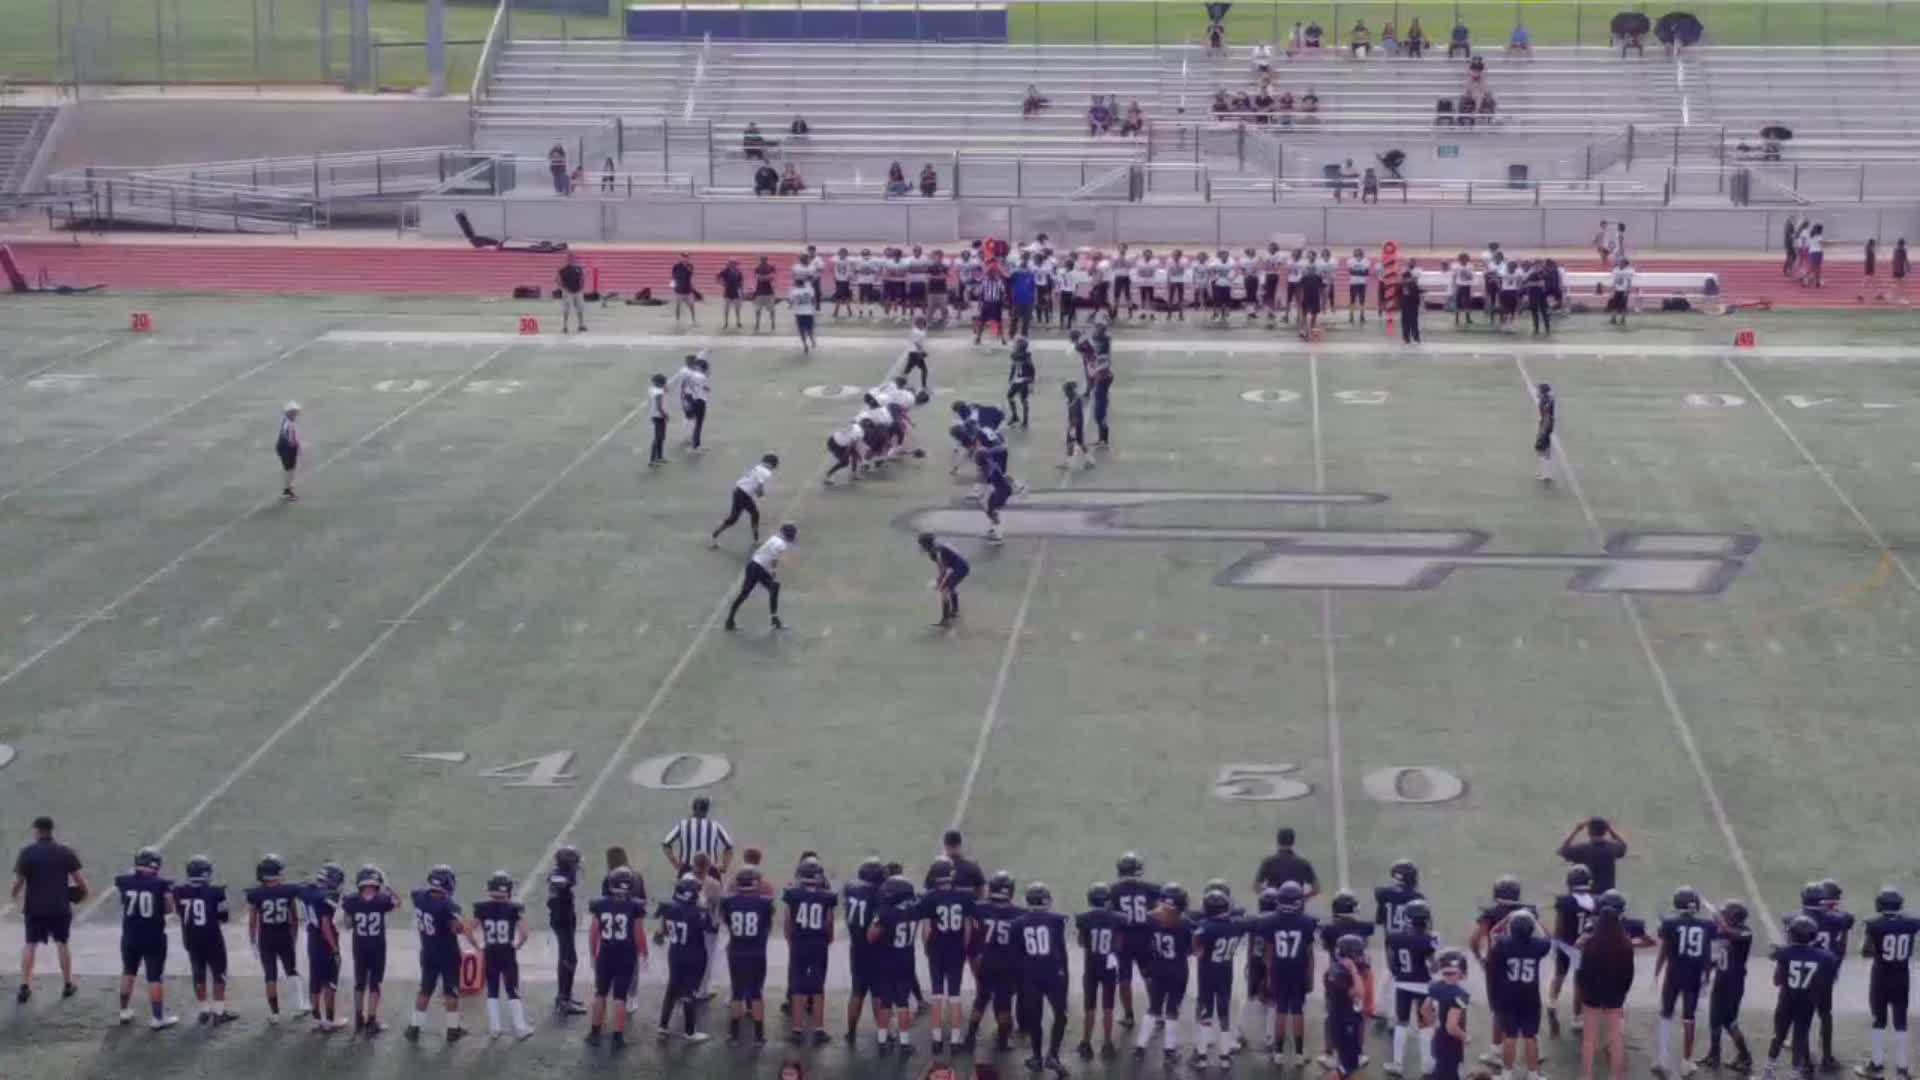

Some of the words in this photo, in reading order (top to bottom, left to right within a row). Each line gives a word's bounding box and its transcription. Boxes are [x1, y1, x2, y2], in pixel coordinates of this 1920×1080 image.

[125, 891, 153, 918] 70
[179, 900, 206, 926] 79
[262, 899, 289, 924] 25
[796, 903, 823, 929] 40
[849, 897, 866, 926] 71
[1119, 896, 1147, 923] 56
[354, 911, 381, 937] 22
[601, 912, 628, 940] 33
[730, 911, 759, 936] 88
[936, 904, 963, 932] 36
[484, 919, 509, 944] 29
[985, 920, 1010, 945] 75
[1024, 926, 1049, 955] 60
[1090, 929, 1112, 955] 18
[1275, 930, 1302, 958] 67
[1676, 926, 1703, 957] 19
[1881, 933, 1909, 961] 90
[1398, 948, 1411, 973] 9
[1506, 957, 1536, 983] 35
[1788, 960, 1818, 989] 57
